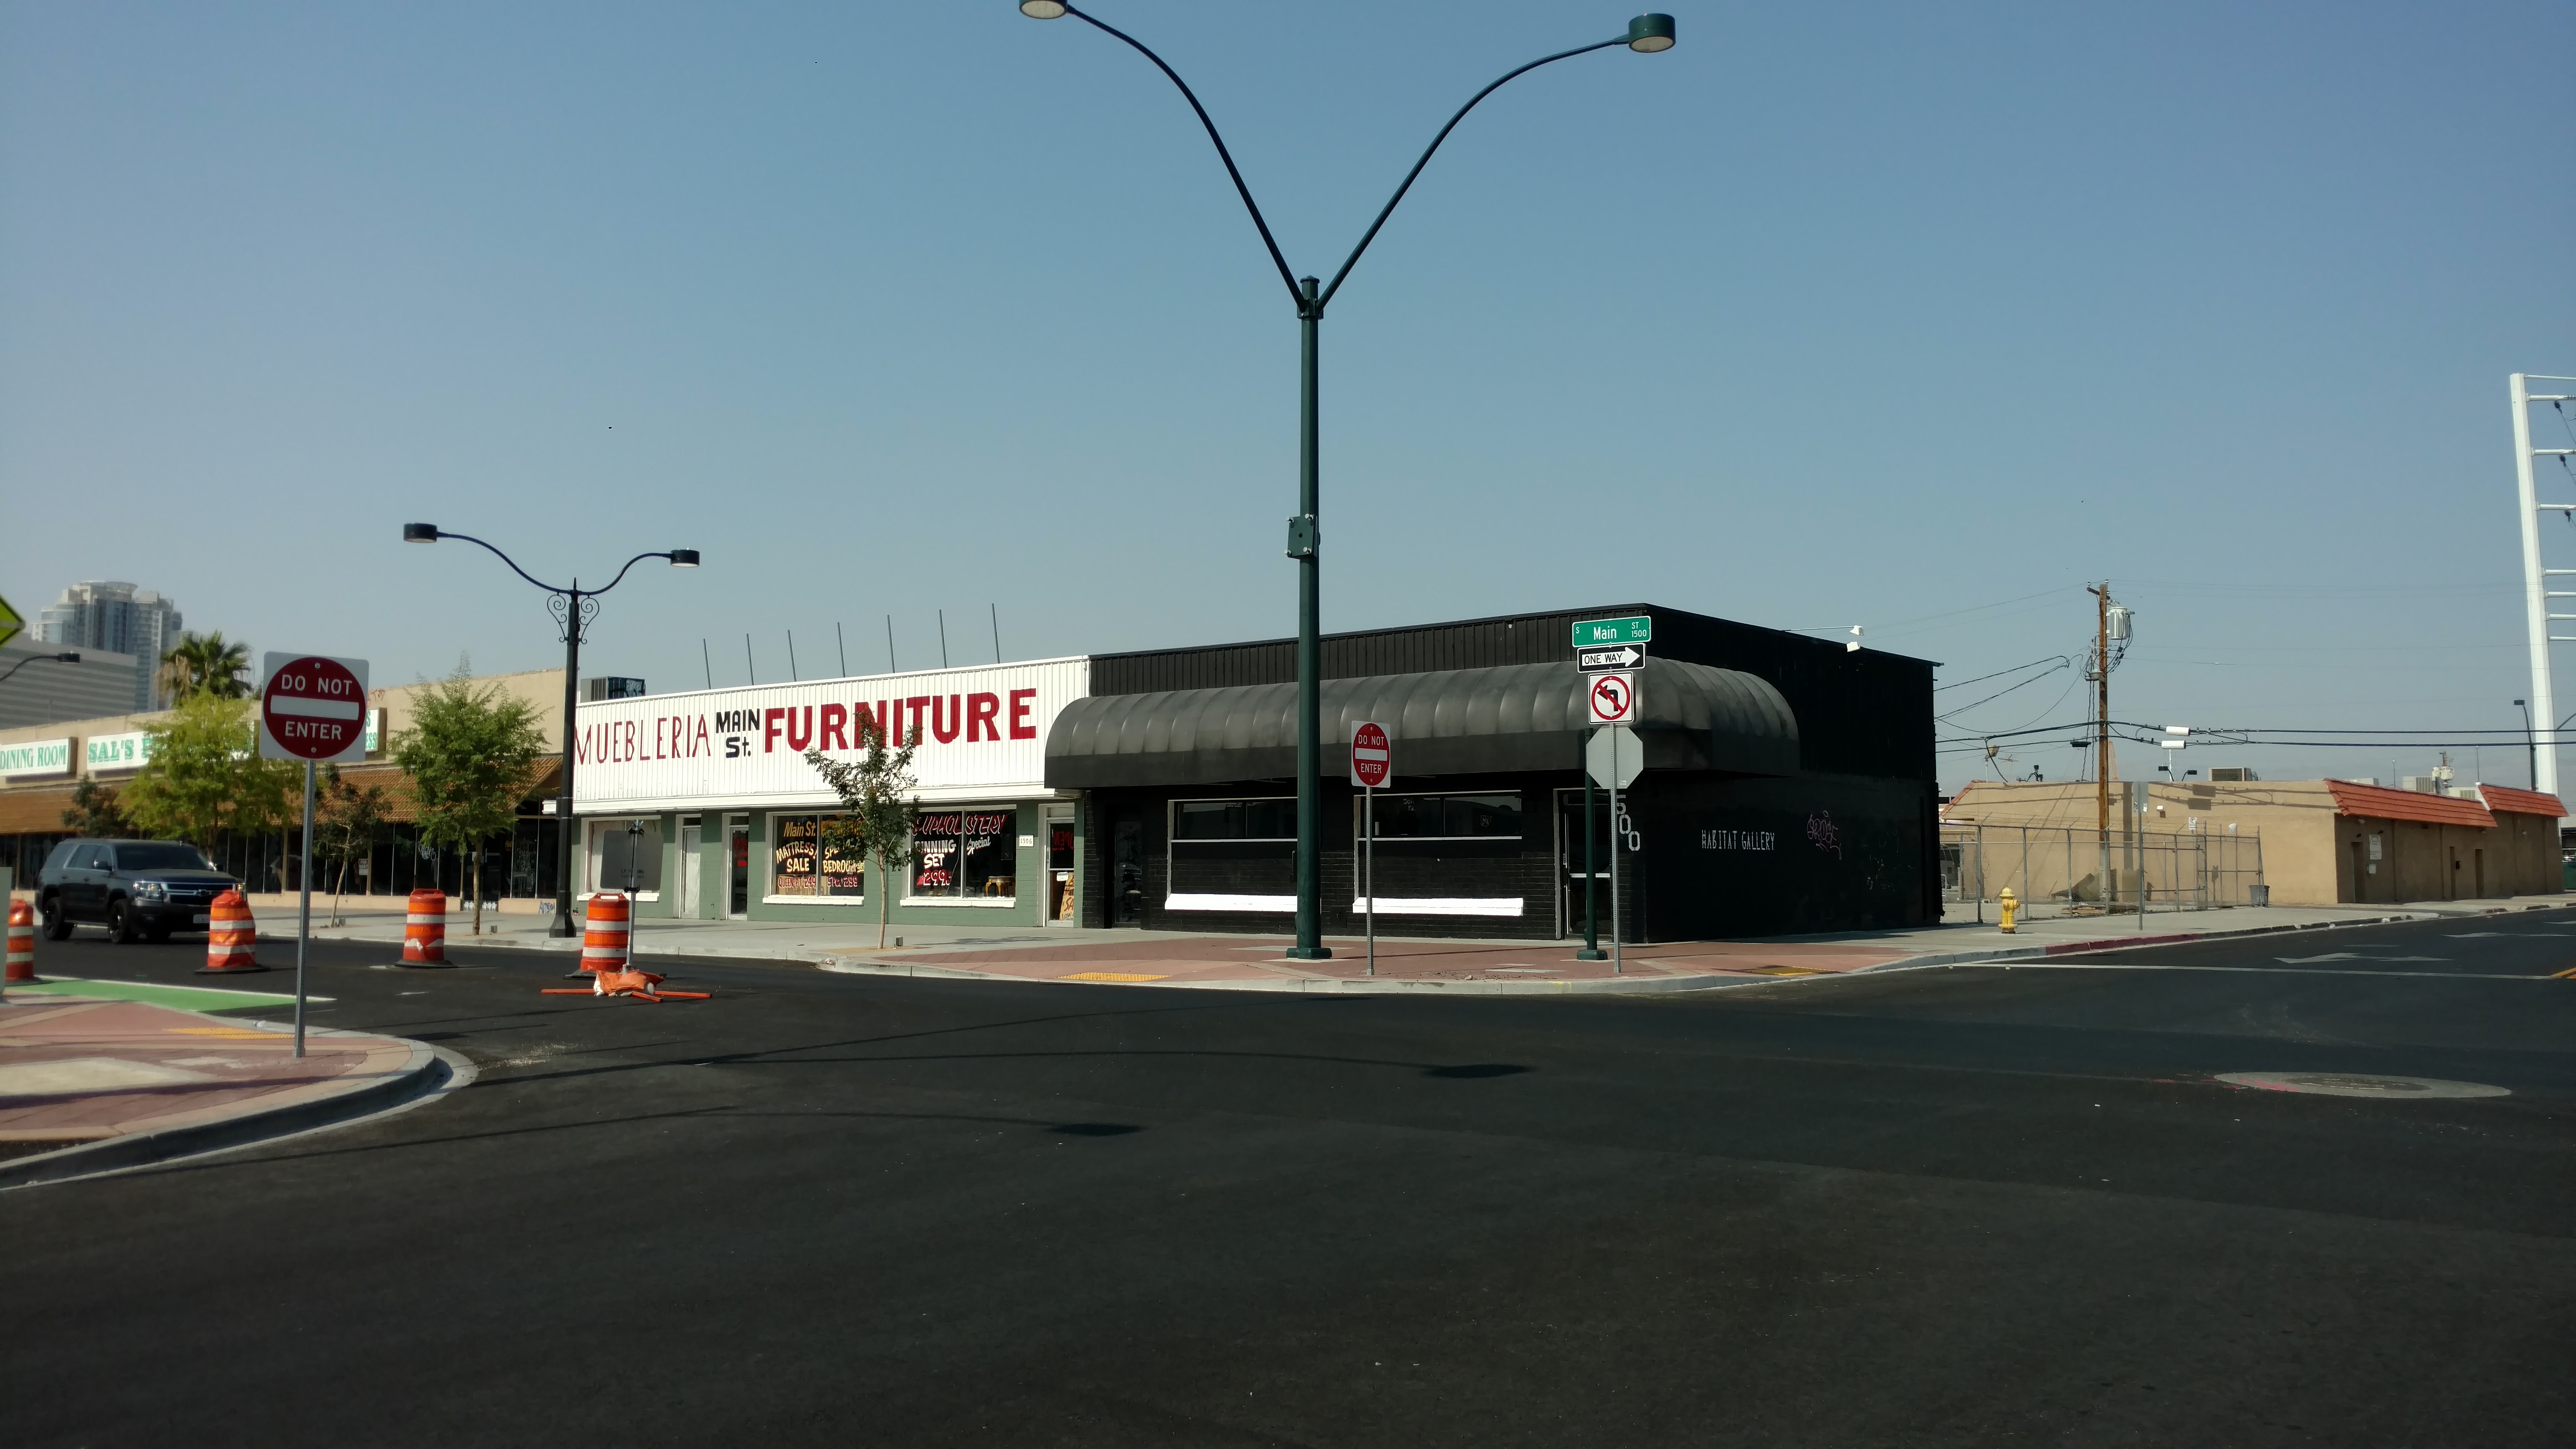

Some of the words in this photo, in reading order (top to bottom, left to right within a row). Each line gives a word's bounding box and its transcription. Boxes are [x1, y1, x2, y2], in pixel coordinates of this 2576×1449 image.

[1593, 626, 1617, 640] Main
[1631, 630, 1647, 638] 1500
[1584, 654, 1601, 665] ONE
[1604, 653, 1623, 663] WAY
[282, 674, 306, 691] DO
[318, 677, 353, 695] NOT
[716, 708, 760, 734] MAIN
[765, 688, 1036, 753] FURNITURE
[285, 721, 342, 740] ENTER
[574, 714, 711, 765] MUEBLERIA
[1358, 735, 1368, 745] DO
[1371, 736, 1384, 746] NOT
[0, 748, 34, 770] DINING
[37, 745, 67, 767] ROOM
[88, 739, 134, 763] SAL'S
[1361, 763, 1382, 774] ENTER
[784, 821, 804, 837] Main
[1702, 830, 1737, 849] HABITAT
[1742, 831, 1775, 850] GALLERY
[787, 858, 810, 872] SALE
[924, 853, 945, 869] SET
